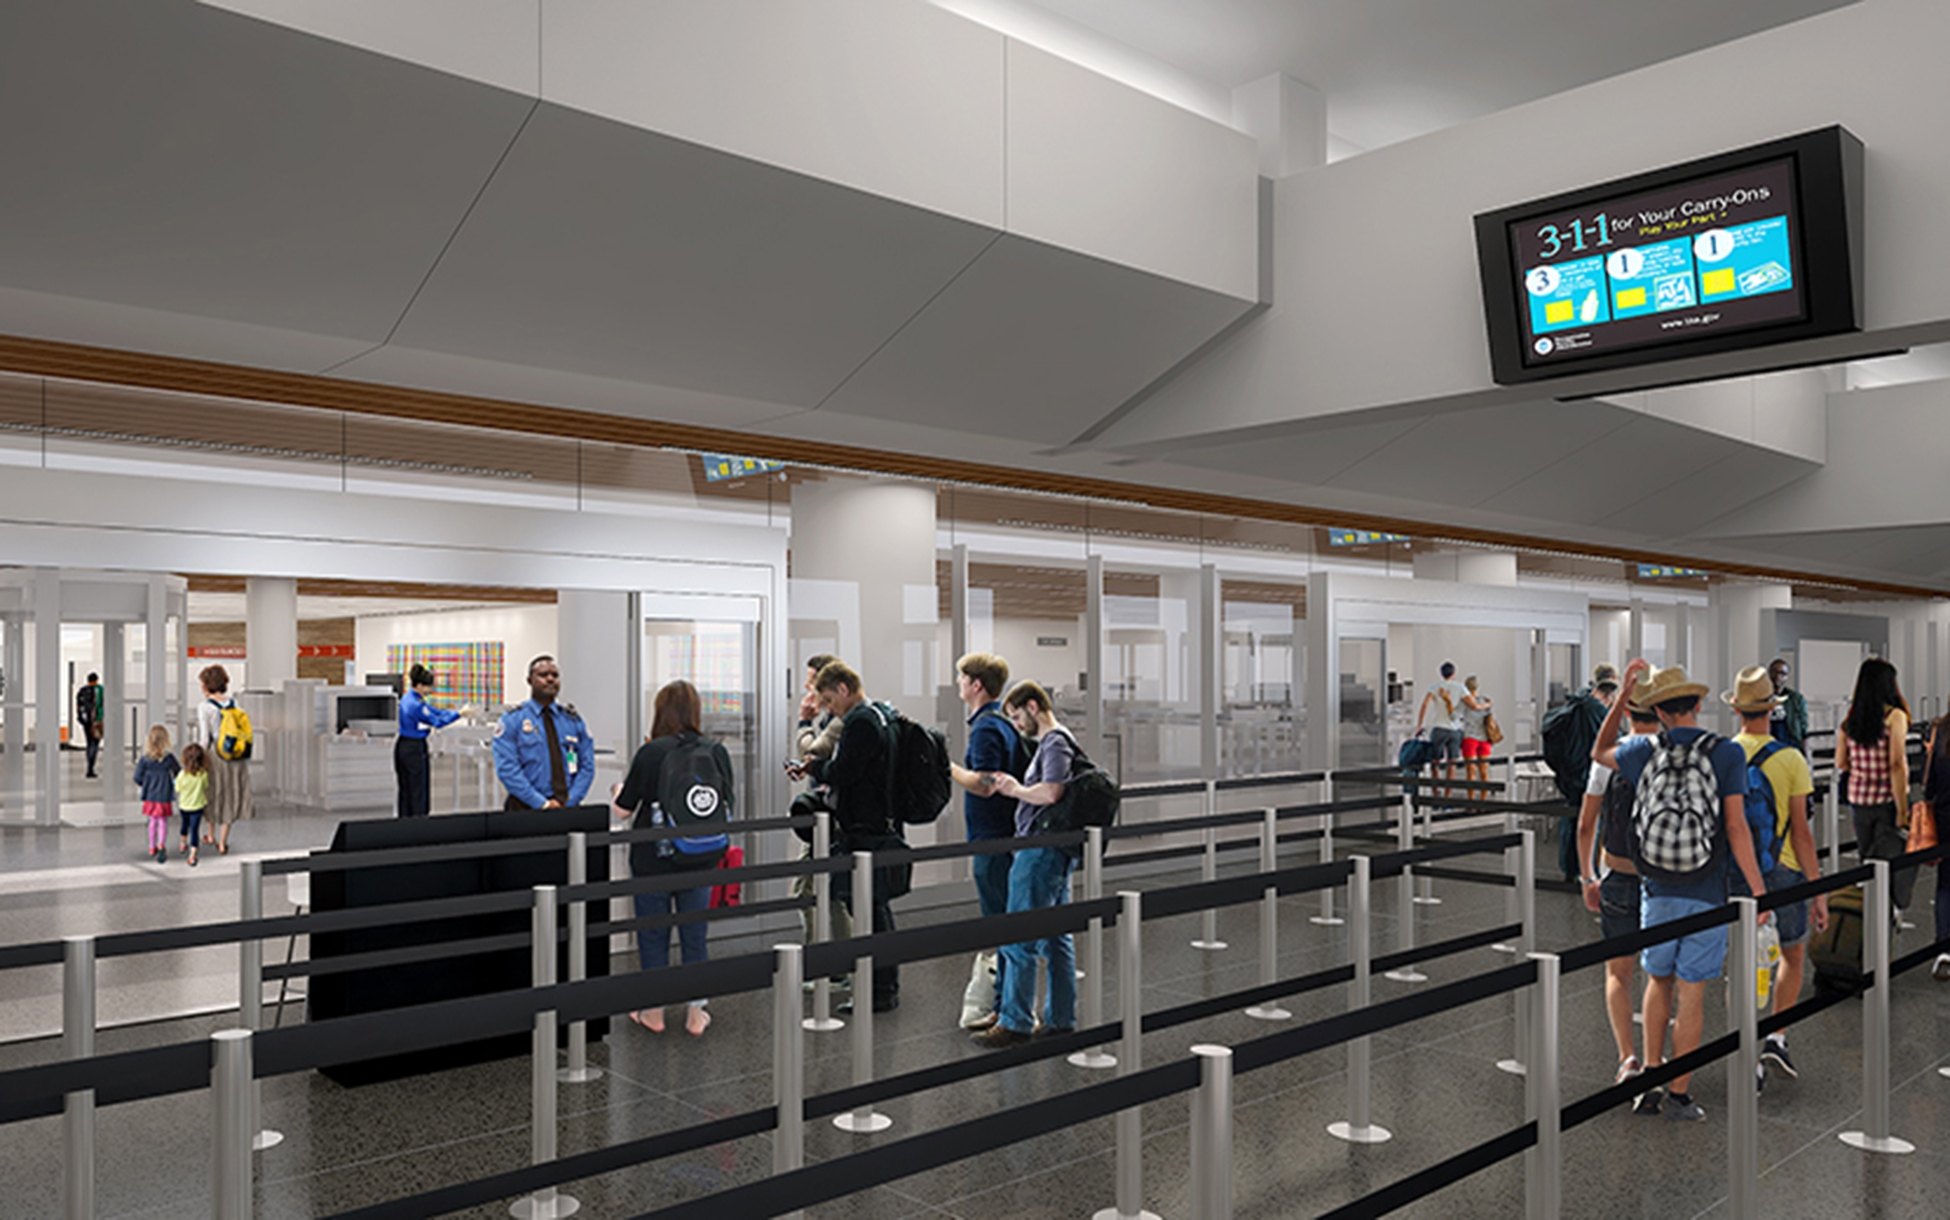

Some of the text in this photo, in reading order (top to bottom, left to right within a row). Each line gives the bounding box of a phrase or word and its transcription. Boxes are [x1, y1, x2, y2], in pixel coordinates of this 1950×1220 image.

[1537, 187, 1771, 258] 3-1-1 for Your Carry-Ons
[1664, 219, 1688, 231] Your
[1535, 269, 1550, 292] 3
